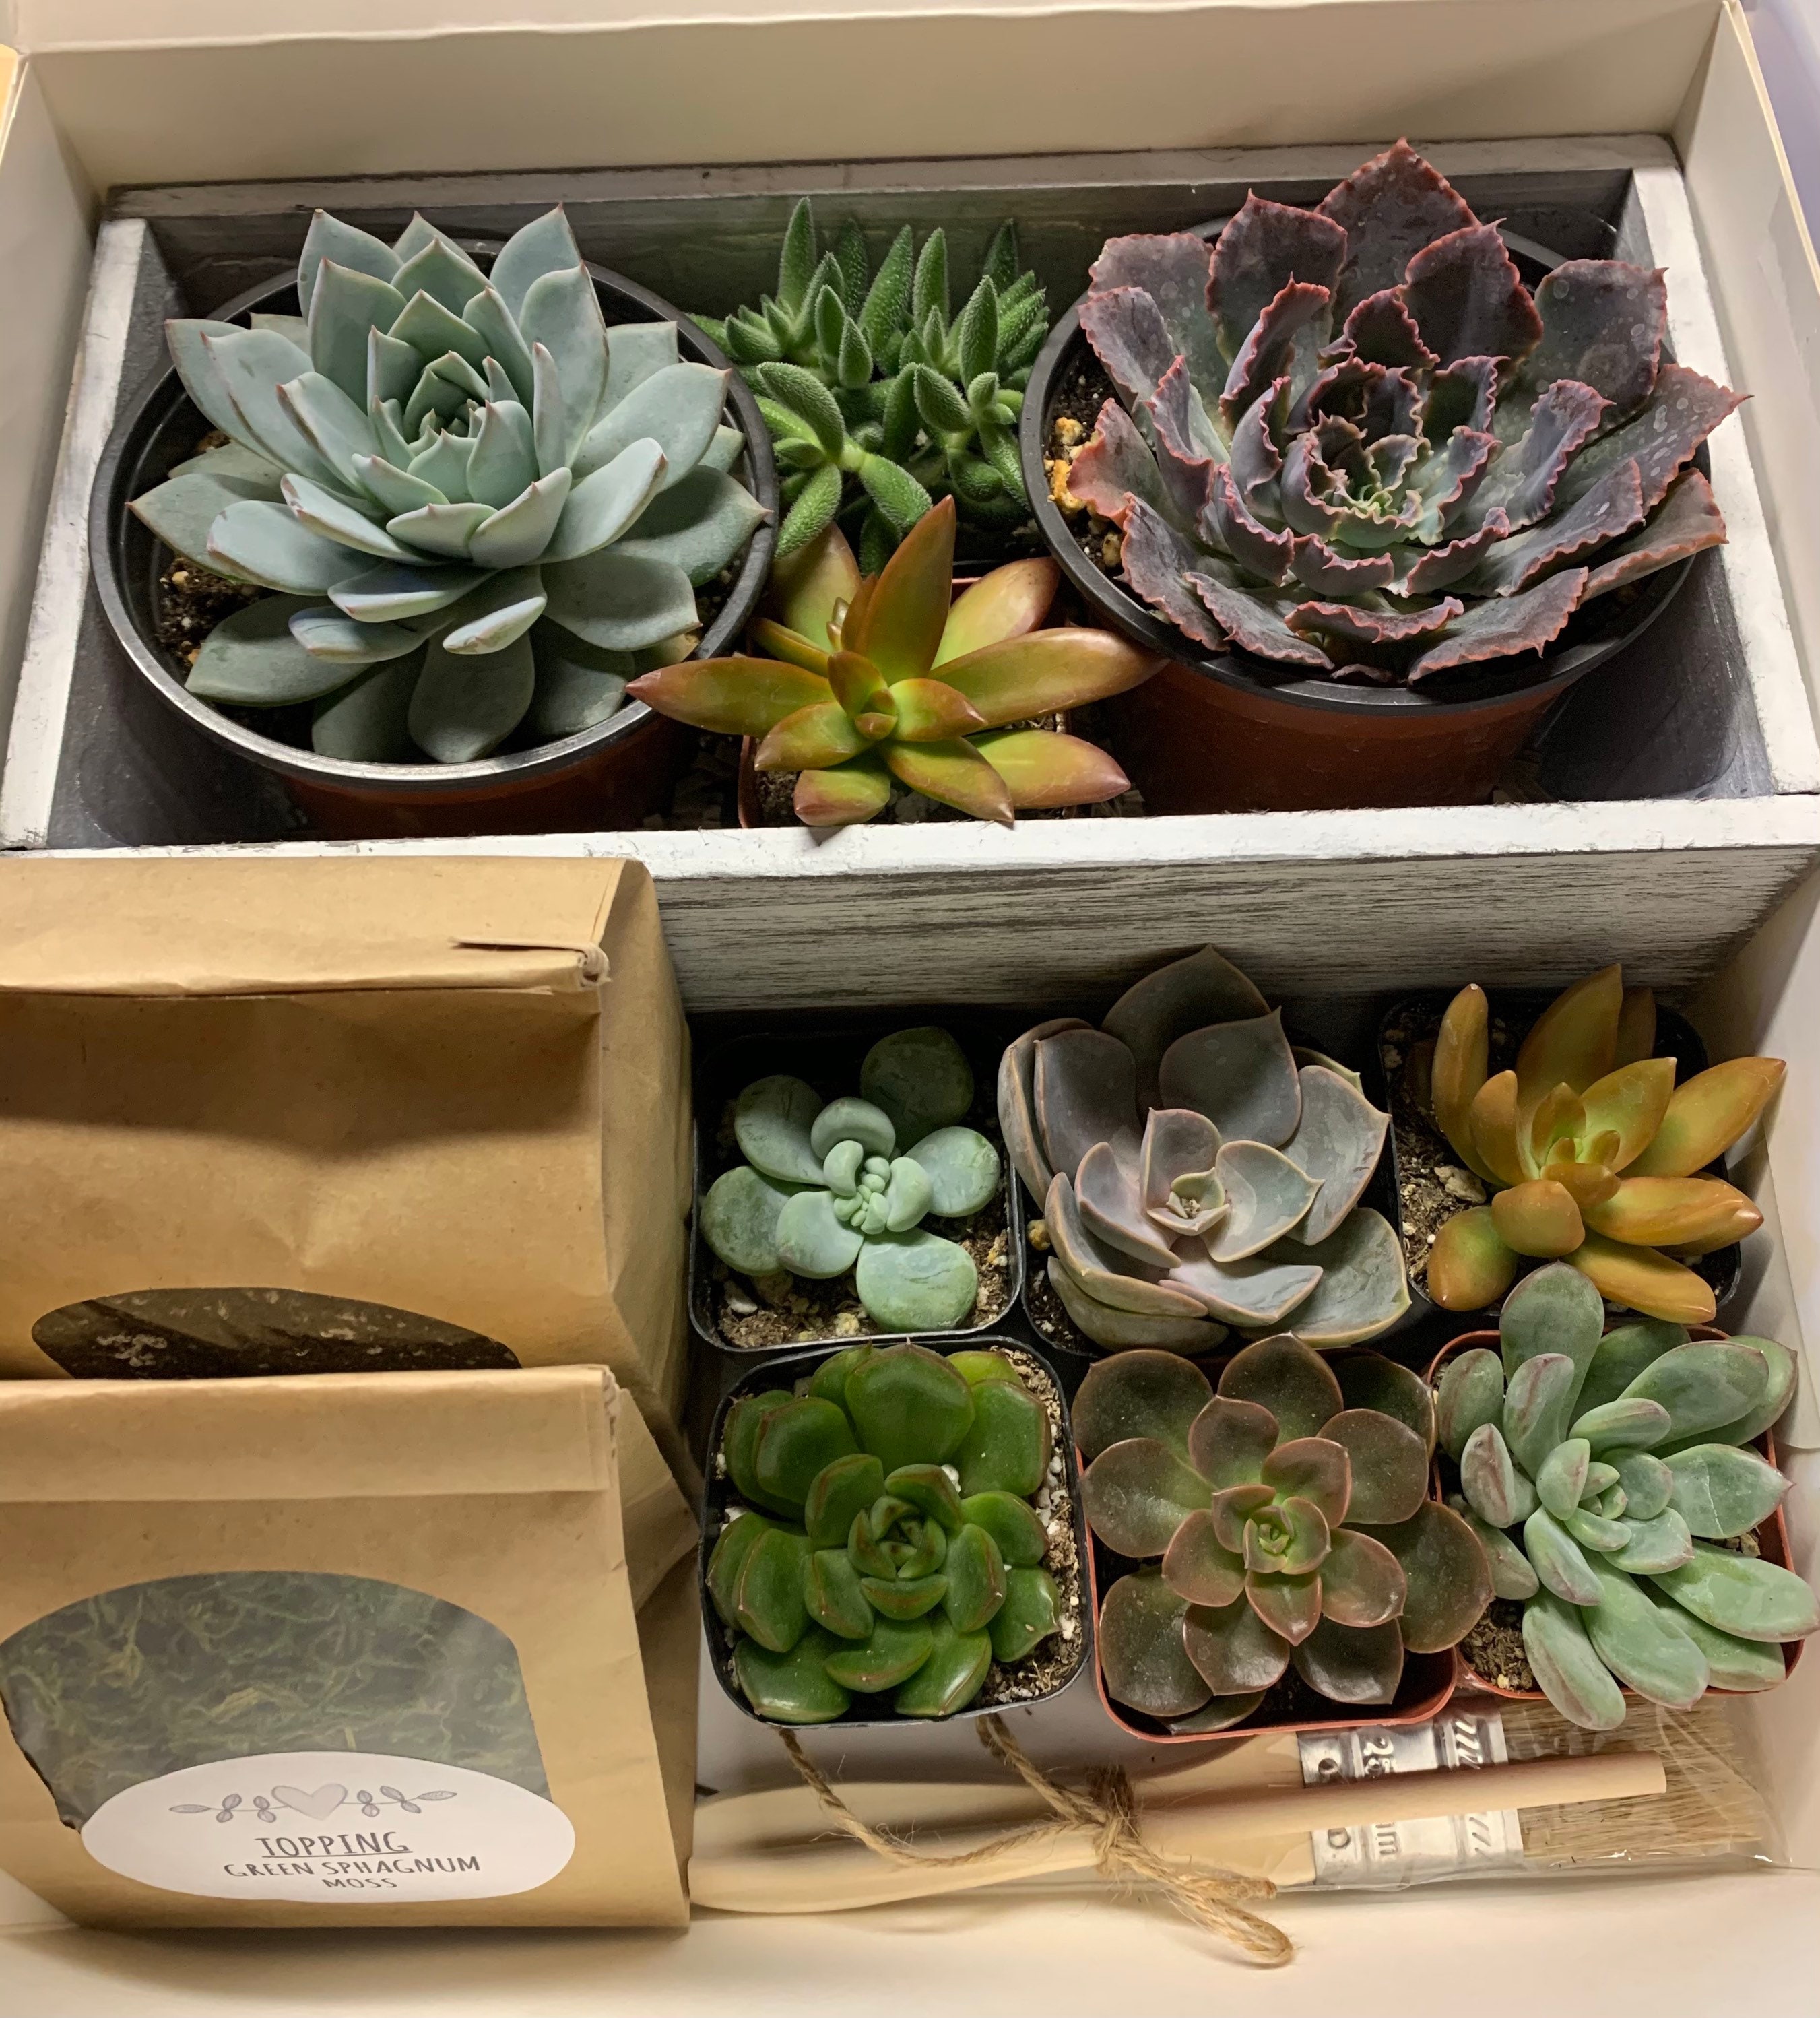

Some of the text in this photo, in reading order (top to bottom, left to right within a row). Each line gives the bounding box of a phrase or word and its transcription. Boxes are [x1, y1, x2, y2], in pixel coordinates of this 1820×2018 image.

[255, 1831, 410, 1856] TOPPING
[224, 1856, 480, 1877] GREEN SPHAGNUM
[321, 1878, 397, 1888] MOSS
